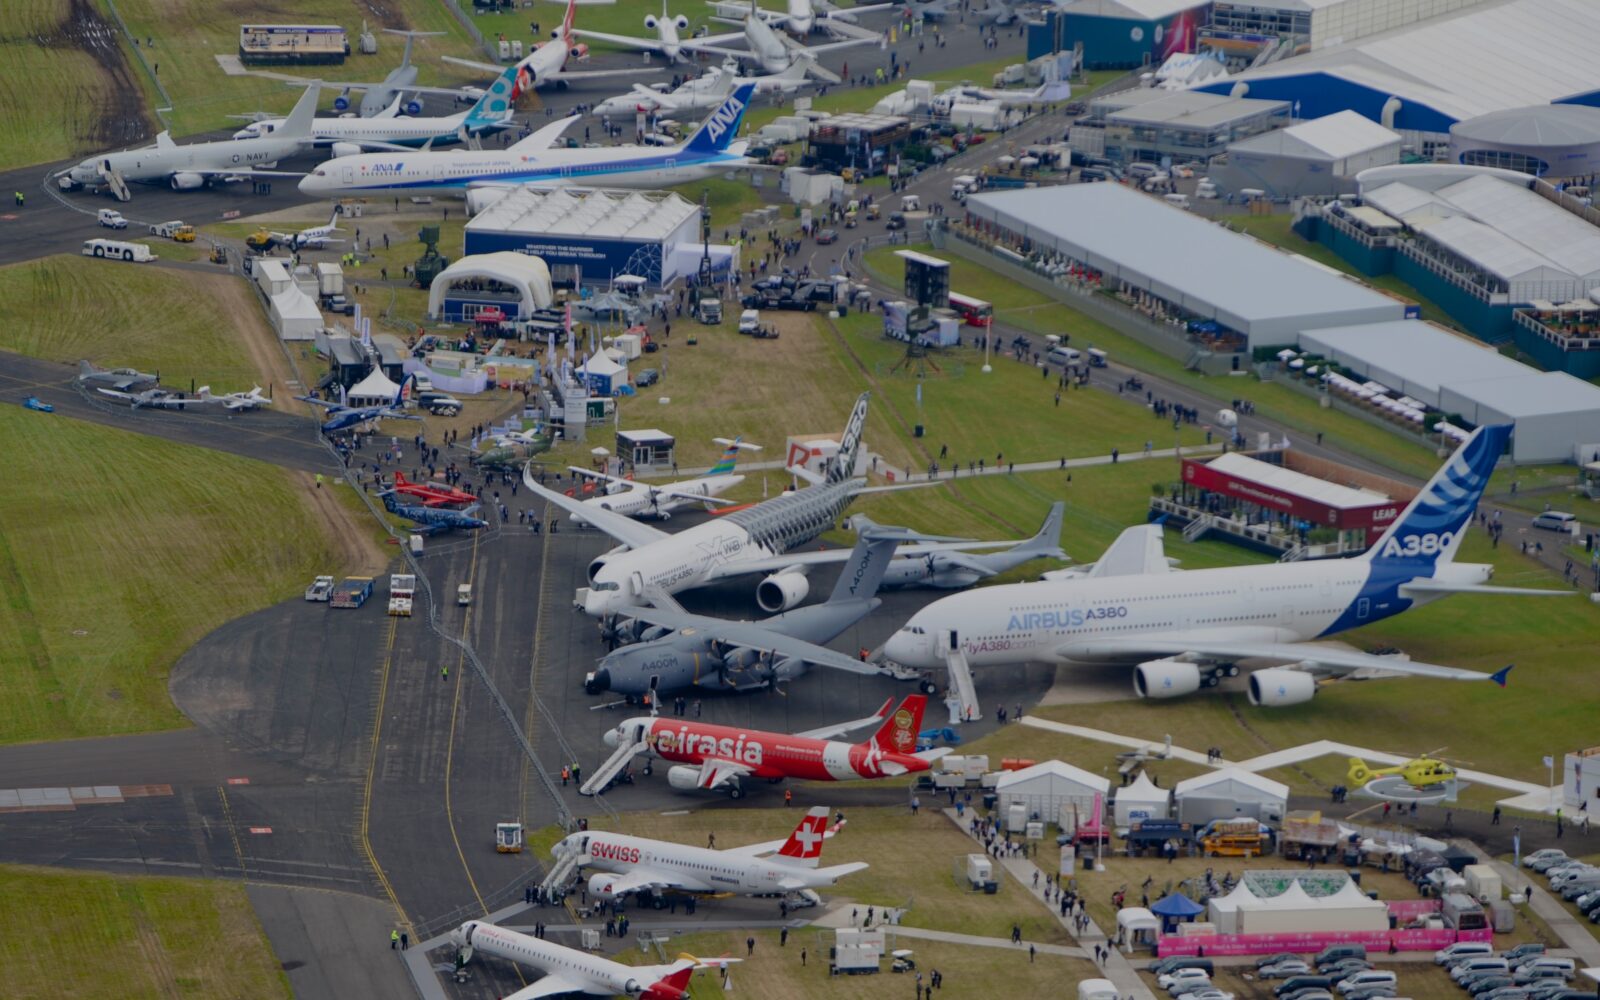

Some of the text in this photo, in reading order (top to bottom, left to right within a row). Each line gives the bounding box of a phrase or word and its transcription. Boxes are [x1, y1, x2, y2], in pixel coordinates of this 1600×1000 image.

[707, 96, 745, 145] ANA
[246, 152, 269, 161] NAVY
[372, 163, 394, 172] ANA
[1380, 532, 1454, 558] A380
[850, 550, 873, 596] A400M
[1006, 606, 1128, 632] AIRBUS A380
[642, 657, 678, 671] A400M
[658, 726, 763, 765] airasia
[591, 842, 640, 863] SWISS
